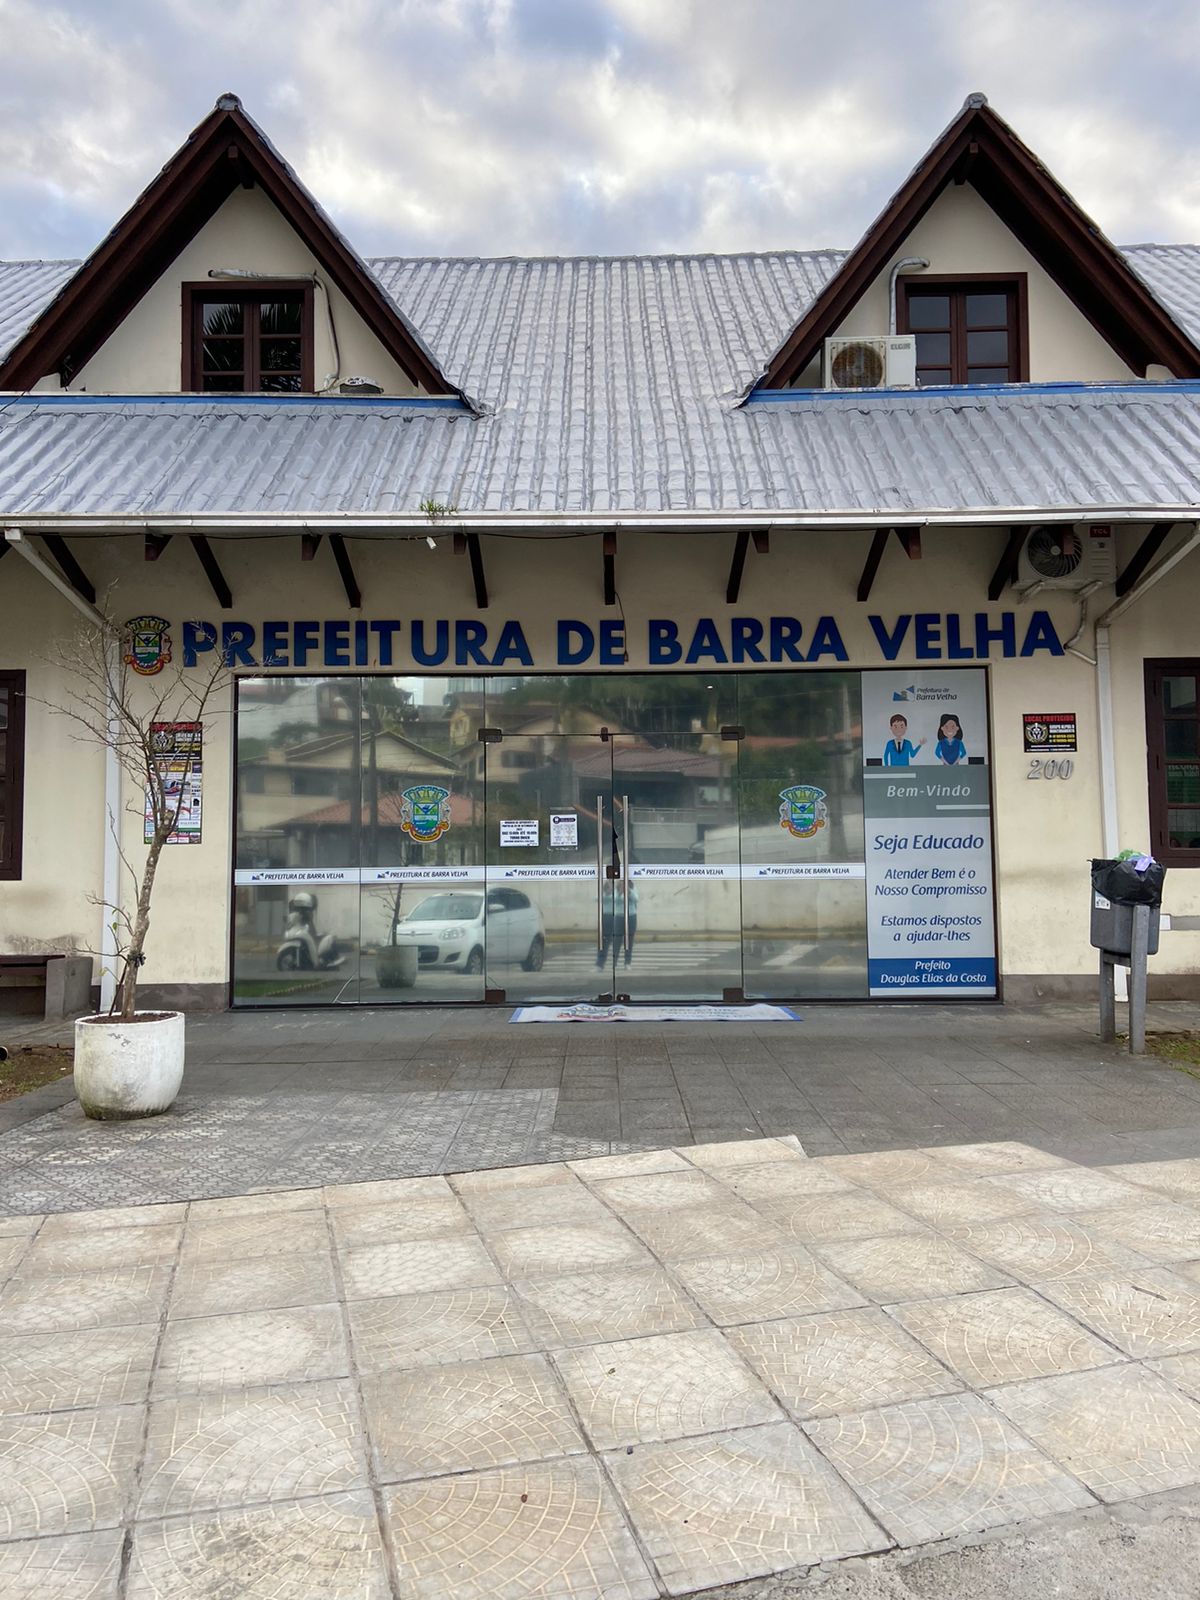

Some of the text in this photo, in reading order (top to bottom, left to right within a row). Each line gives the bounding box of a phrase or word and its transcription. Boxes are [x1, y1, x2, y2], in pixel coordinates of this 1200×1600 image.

[182, 611, 1066, 668] PREFEITURA DE BARRA VELHA
[1027, 759, 1074, 780] 200
[886, 784, 971, 798] Bem-Vindo
[873, 834, 984, 854] Seja Educado
[884, 868, 976, 880] Atender Bem é o
[874, 884, 987, 898] Nosso Compromisso
[881, 915, 982, 928] Estamos dispostos
[893, 930, 971, 944] a ajudar-lhes
[915, 961, 951, 972] Prefeito
[880, 973, 987, 986] Douglas Elias da Costa
